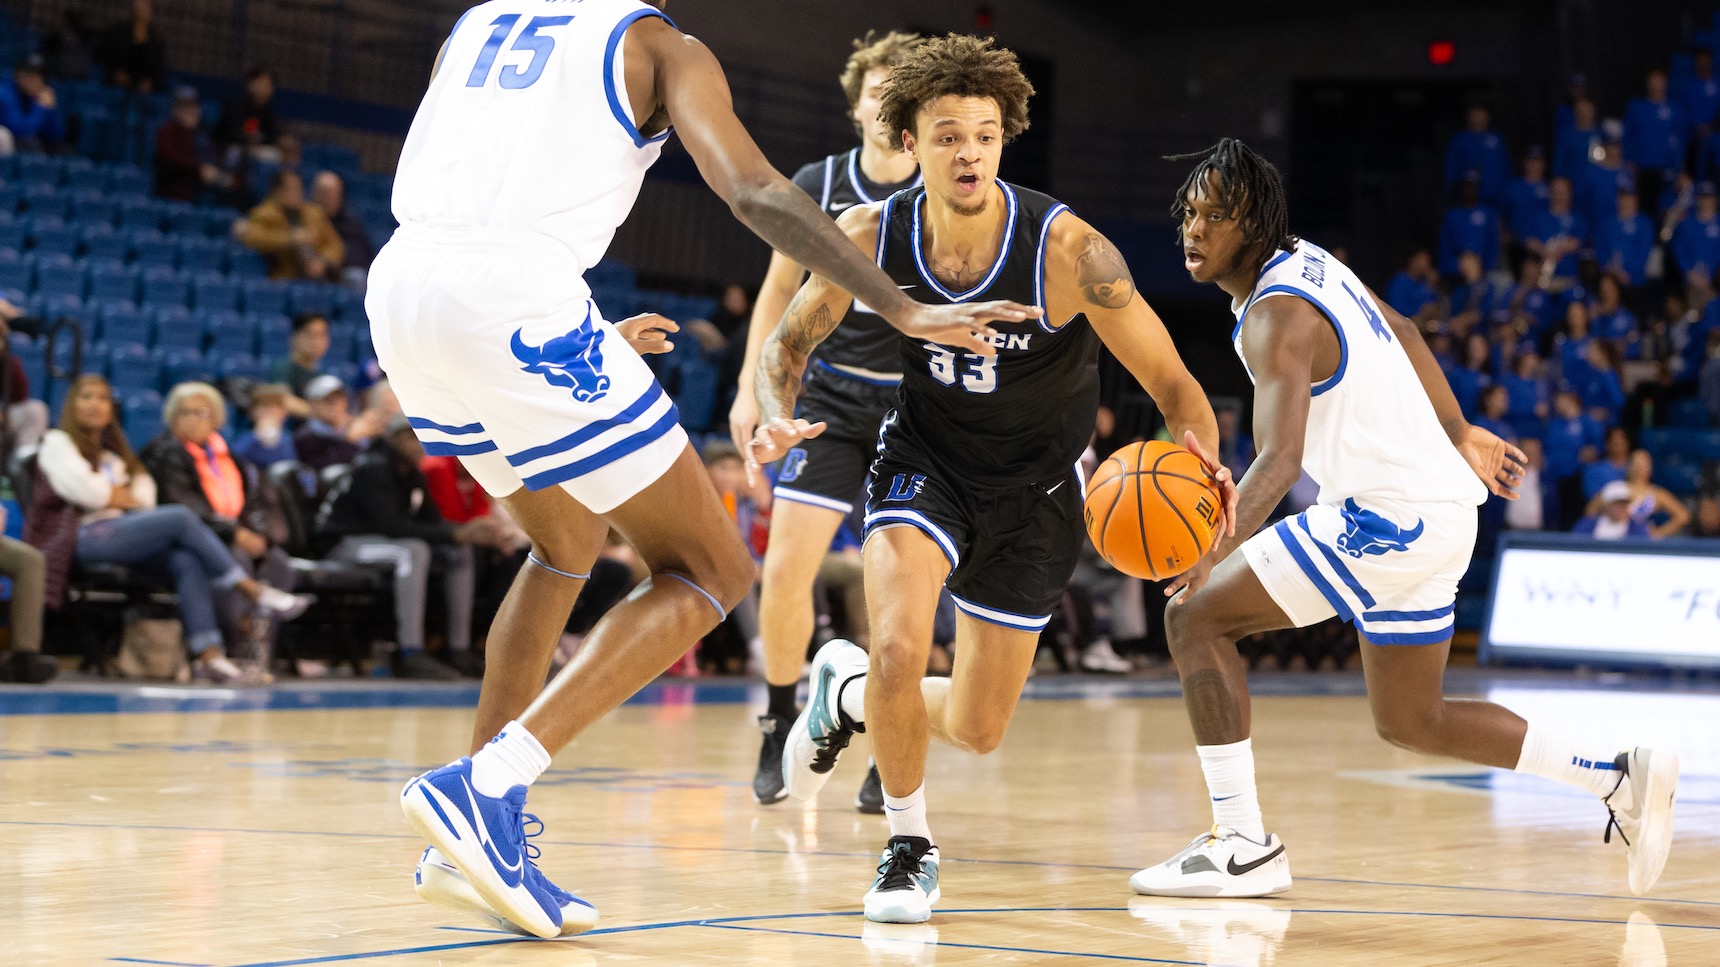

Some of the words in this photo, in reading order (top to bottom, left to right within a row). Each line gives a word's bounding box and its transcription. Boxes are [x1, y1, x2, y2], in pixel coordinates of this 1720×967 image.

[466, 14, 576, 90] 15
[1341, 280, 1392, 343] 4
[920, 342, 999, 394] 33
